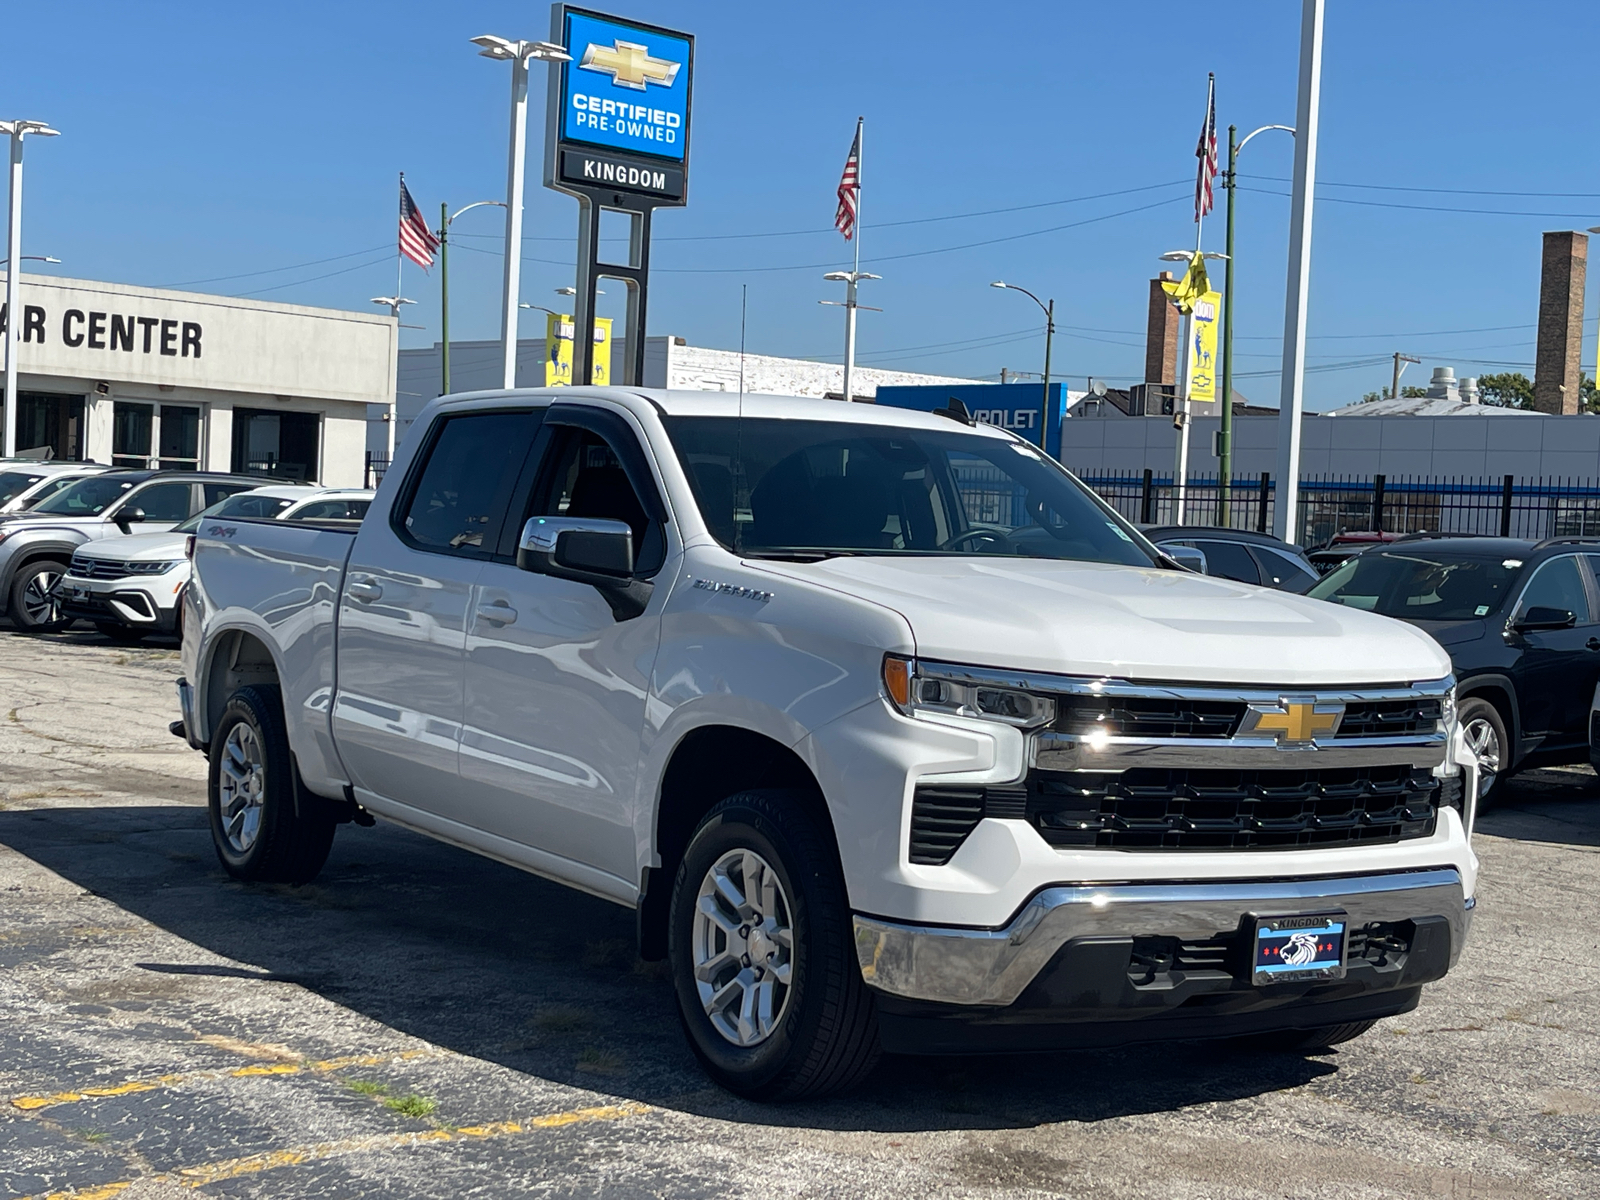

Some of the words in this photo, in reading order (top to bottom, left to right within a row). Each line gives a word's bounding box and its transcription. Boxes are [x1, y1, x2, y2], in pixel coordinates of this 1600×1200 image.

[572, 93, 681, 128] CERTIFIED
[577, 111, 676, 144] PRE-OWNED
[584, 160, 666, 190] KINGDOM
[62, 308, 203, 359] CENTER
[1279, 917, 1328, 928] KINGDOM
